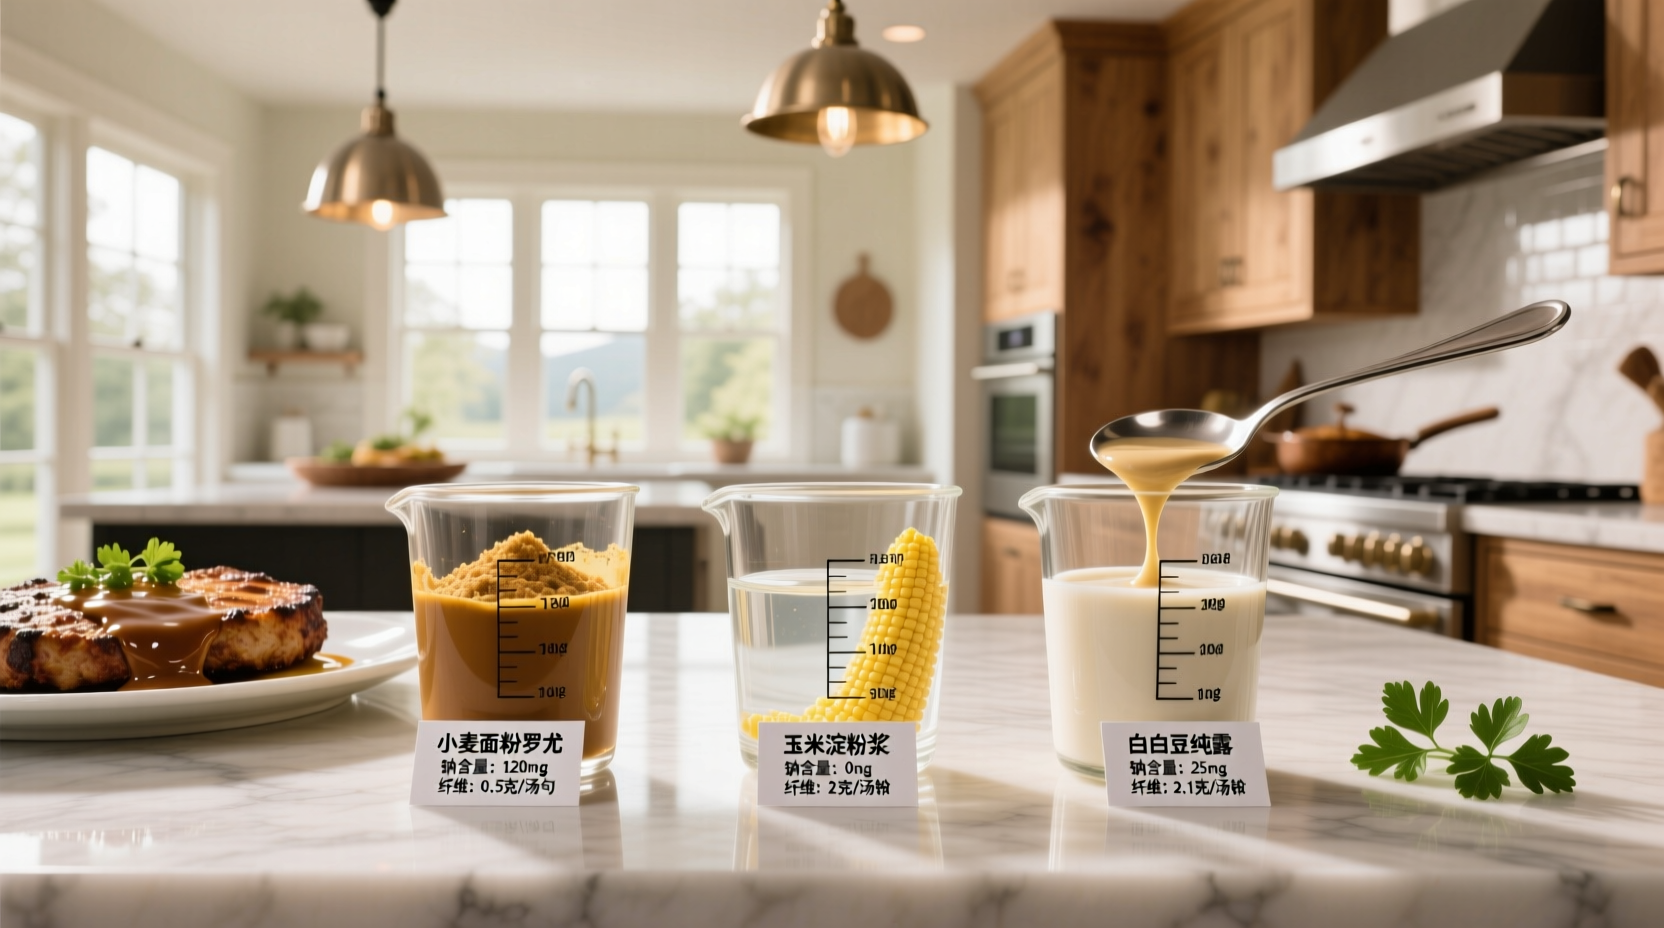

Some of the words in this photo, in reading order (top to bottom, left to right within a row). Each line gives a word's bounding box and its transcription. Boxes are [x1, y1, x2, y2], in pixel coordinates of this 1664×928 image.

[784, 733, 890, 756] 玉米淀粉浆
